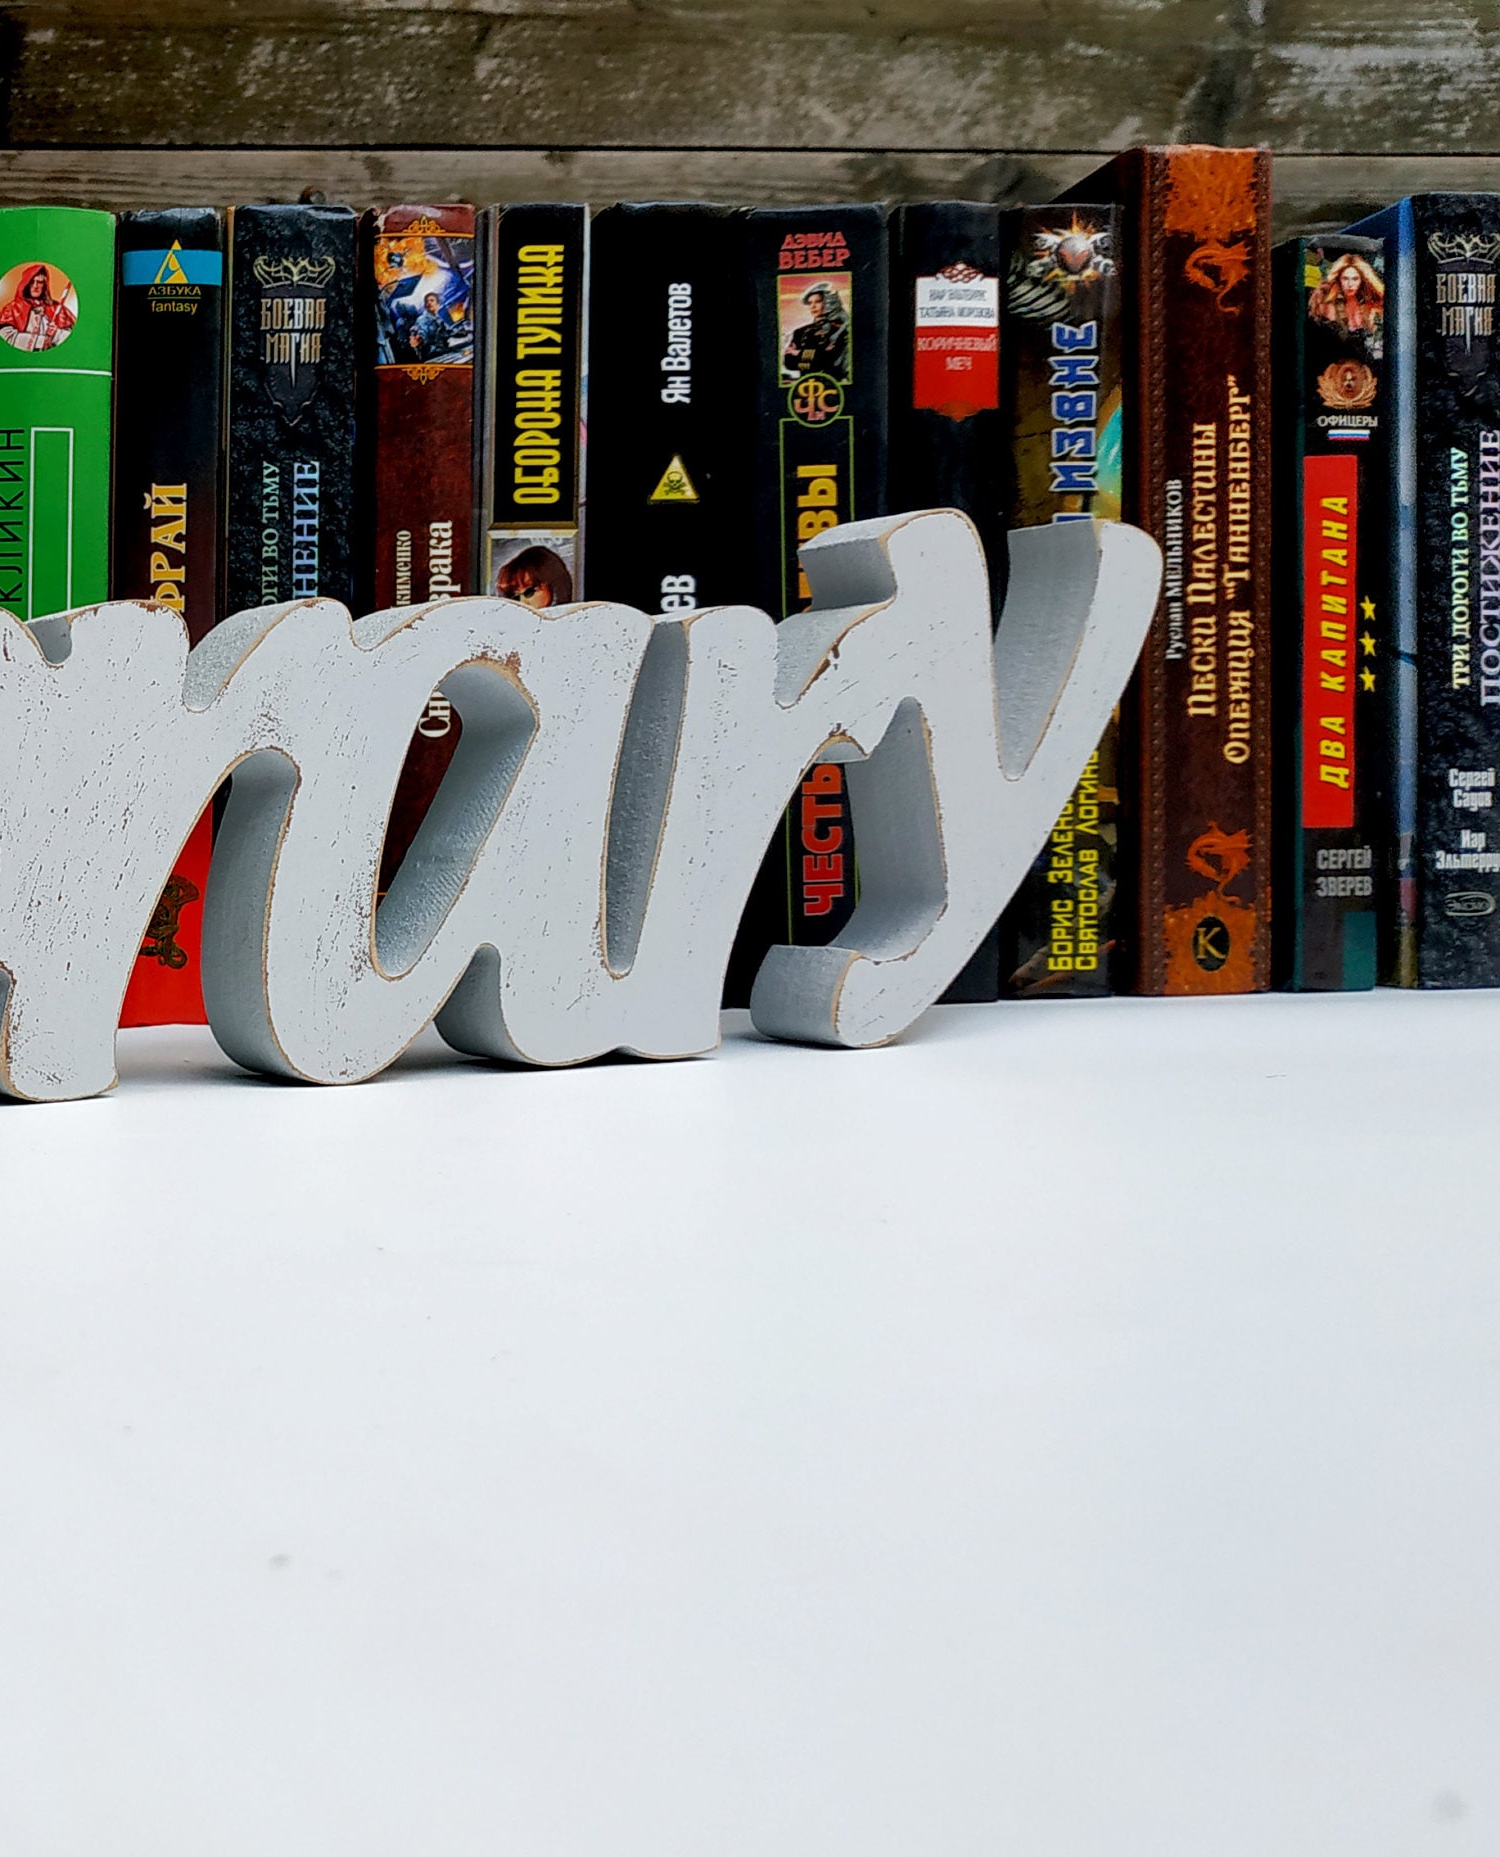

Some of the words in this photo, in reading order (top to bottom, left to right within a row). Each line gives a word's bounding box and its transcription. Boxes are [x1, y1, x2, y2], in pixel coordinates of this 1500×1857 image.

[778, 248, 850, 270] ВЕБЕР
[781, 231, 847, 250] ДЭВИД
[148, 286, 202, 296] АЗБУКА
[151, 301, 198, 315] fantasy
[516, 243, 565, 359] ТУПИКА
[1436, 273, 1496, 304] БОЕВАЯ
[260, 298, 326, 330] БОЕВАЯ
[660, 282, 693, 373] Валетов
[1440, 306, 1495, 352] МАГИЯ
[264, 332, 324, 386] МАГИЯ
[660, 381, 692, 405] Ян
[513, 369, 562, 505] ОБОРОНА
[1316, 415, 1378, 428] ОФИЦЕРЫ
[262, 461, 280, 523] ТЬМУ
[1450, 447, 1469, 508] ТЬМУ
[262, 528, 279, 560] ВО
[1165, 479, 1183, 599] МЕЛЬНИКОВ
[1451, 511, 1469, 541] ВО
[1451, 547, 1471, 639] ДОРОГИ
[1480, 429, 1500, 707] ПОСТИЖЕНИЕ
[1320, 497, 1349, 692] КАПИТАНА
[1165, 605, 1187, 661] Руслан
[1452, 643, 1471, 690] ТРИ
[1320, 716, 1349, 789] ДВА
[1449, 768, 1495, 790] Сергей
[802, 763, 844, 917] ЧЕСТЬ
[1316, 845, 1372, 870] СЕРГЕЙ
[1075, 849, 1099, 971] СВЯТОСЛАВ
[1316, 876, 1372, 897] ЗВЕРЕВ
[1047, 899, 1074, 971] БОРИС
